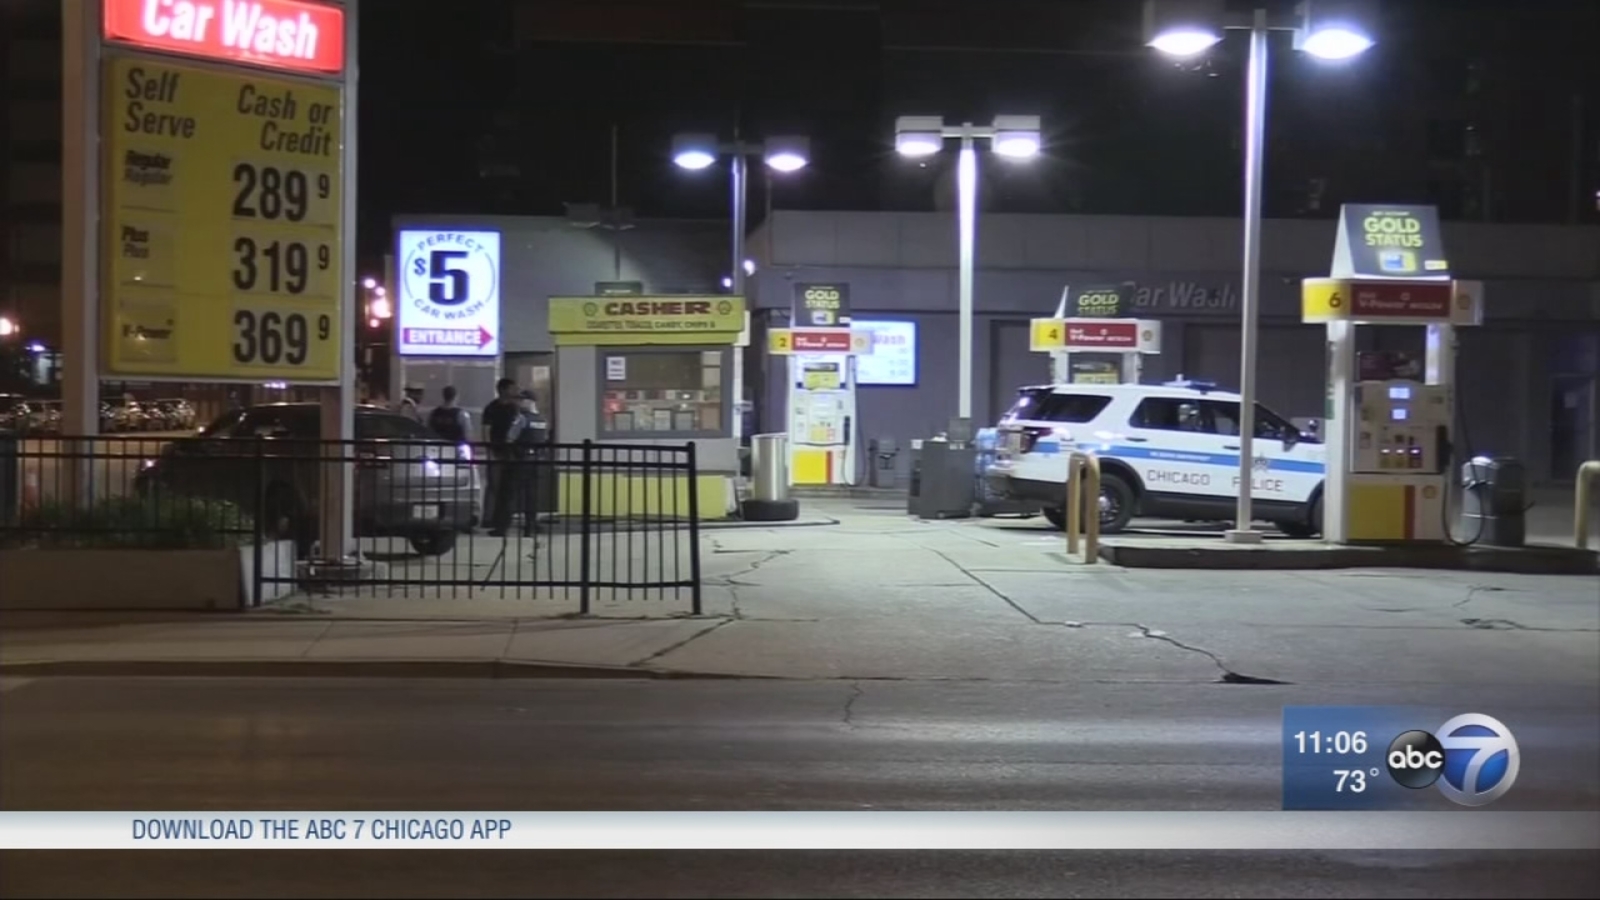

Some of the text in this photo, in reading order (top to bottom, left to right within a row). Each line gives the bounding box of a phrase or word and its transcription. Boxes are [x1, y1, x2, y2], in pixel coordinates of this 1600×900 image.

[143, 0, 319, 59] Car Wash
[125, 67, 180, 103] Self
[236, 84, 334, 125] Cash or
[124, 101, 196, 139] Serve
[259, 120, 332, 157] Credit
[232, 163, 331, 222] 289 9
[1363, 217, 1421, 234] GOLD
[416, 233, 485, 252] PERFECT
[1364, 233, 1424, 247] STATUS
[232, 236, 331, 294] 319 9
[804, 289, 840, 300] GOLD
[804, 300, 841, 309] STATUS
[1078, 293, 1119, 306] GOLD
[1328, 292, 1342, 309] 6
[413, 298, 485, 319] CAR WASH
[232, 310, 331, 365] 369 9
[409, 329, 481, 344] ENTRANCE
[779, 337, 787, 348] 2
[1049, 328, 1058, 340] 4
[1146, 469, 1285, 492] CHICAGO PLICE
